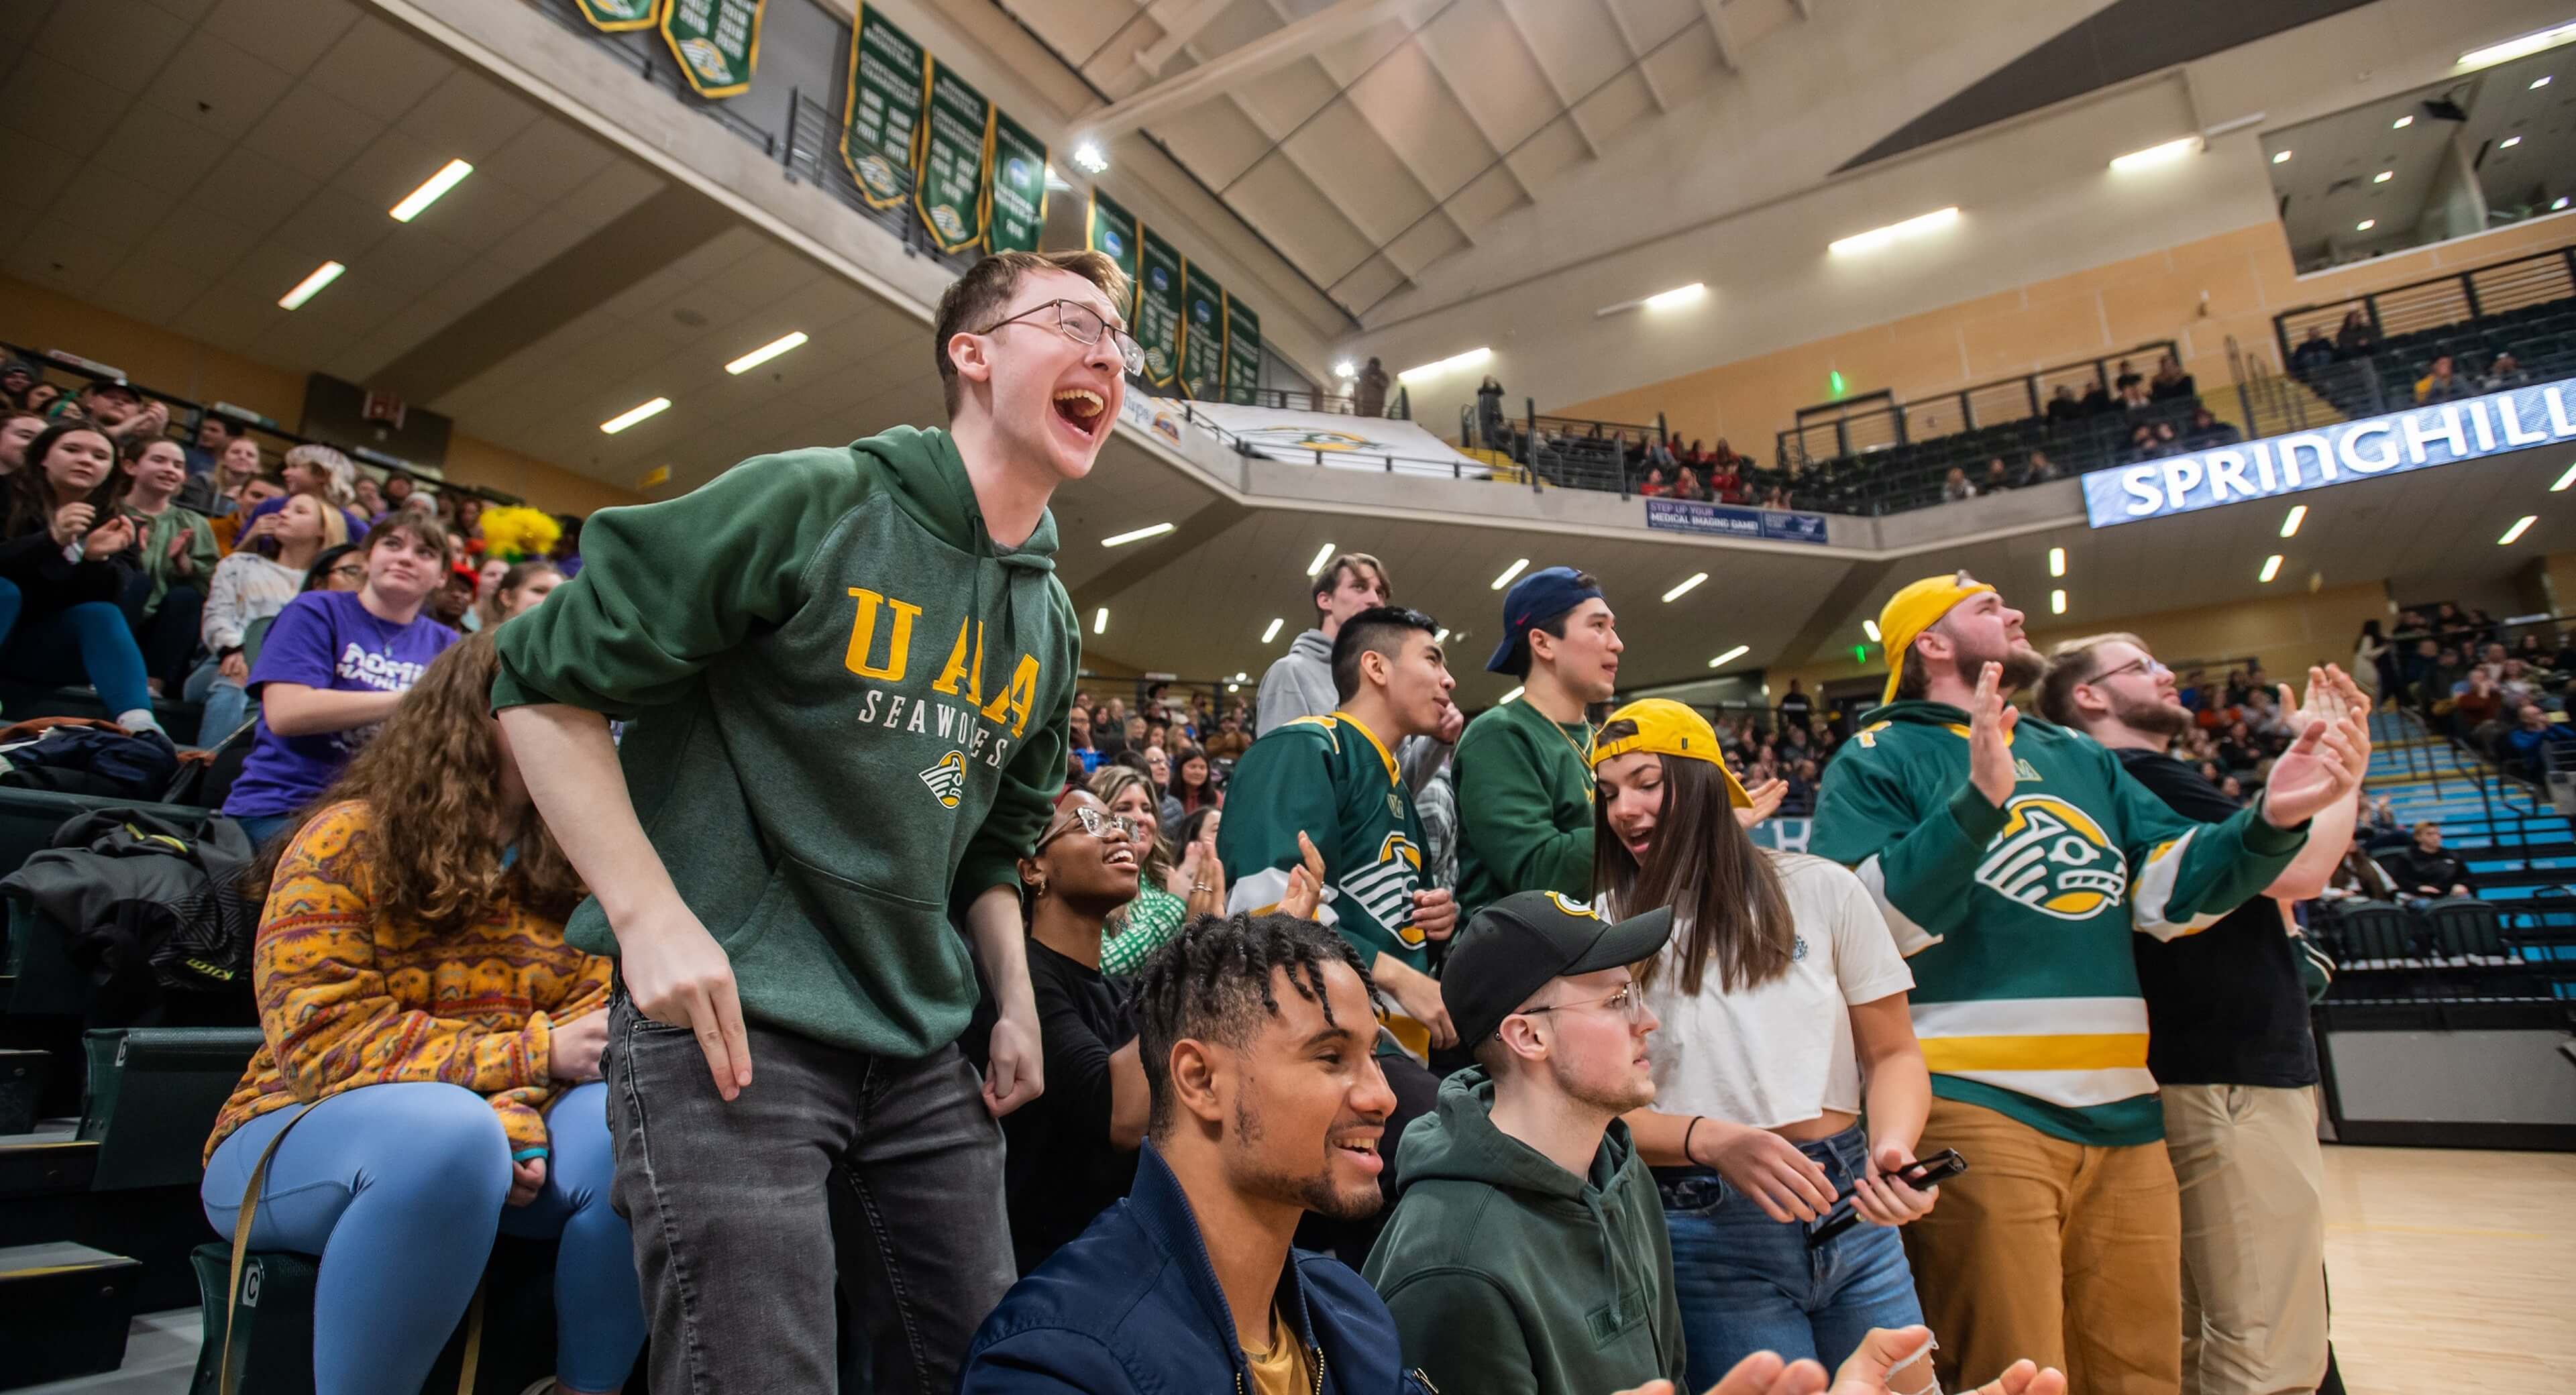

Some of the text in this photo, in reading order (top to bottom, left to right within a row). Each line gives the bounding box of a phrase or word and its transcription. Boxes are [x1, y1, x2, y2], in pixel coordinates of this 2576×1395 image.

[2122, 387, 2576, 516] SPRINGHILL
[1651, 503, 1714, 516] STEP UP YOUR
[1652, 512, 1690, 524] MEDICAL
[1692, 516, 1729, 527] IMAGING
[845, 586, 1039, 738] UAA
[859, 689, 1008, 767] SEAWOES
[248, 1271, 259, 1300] C
